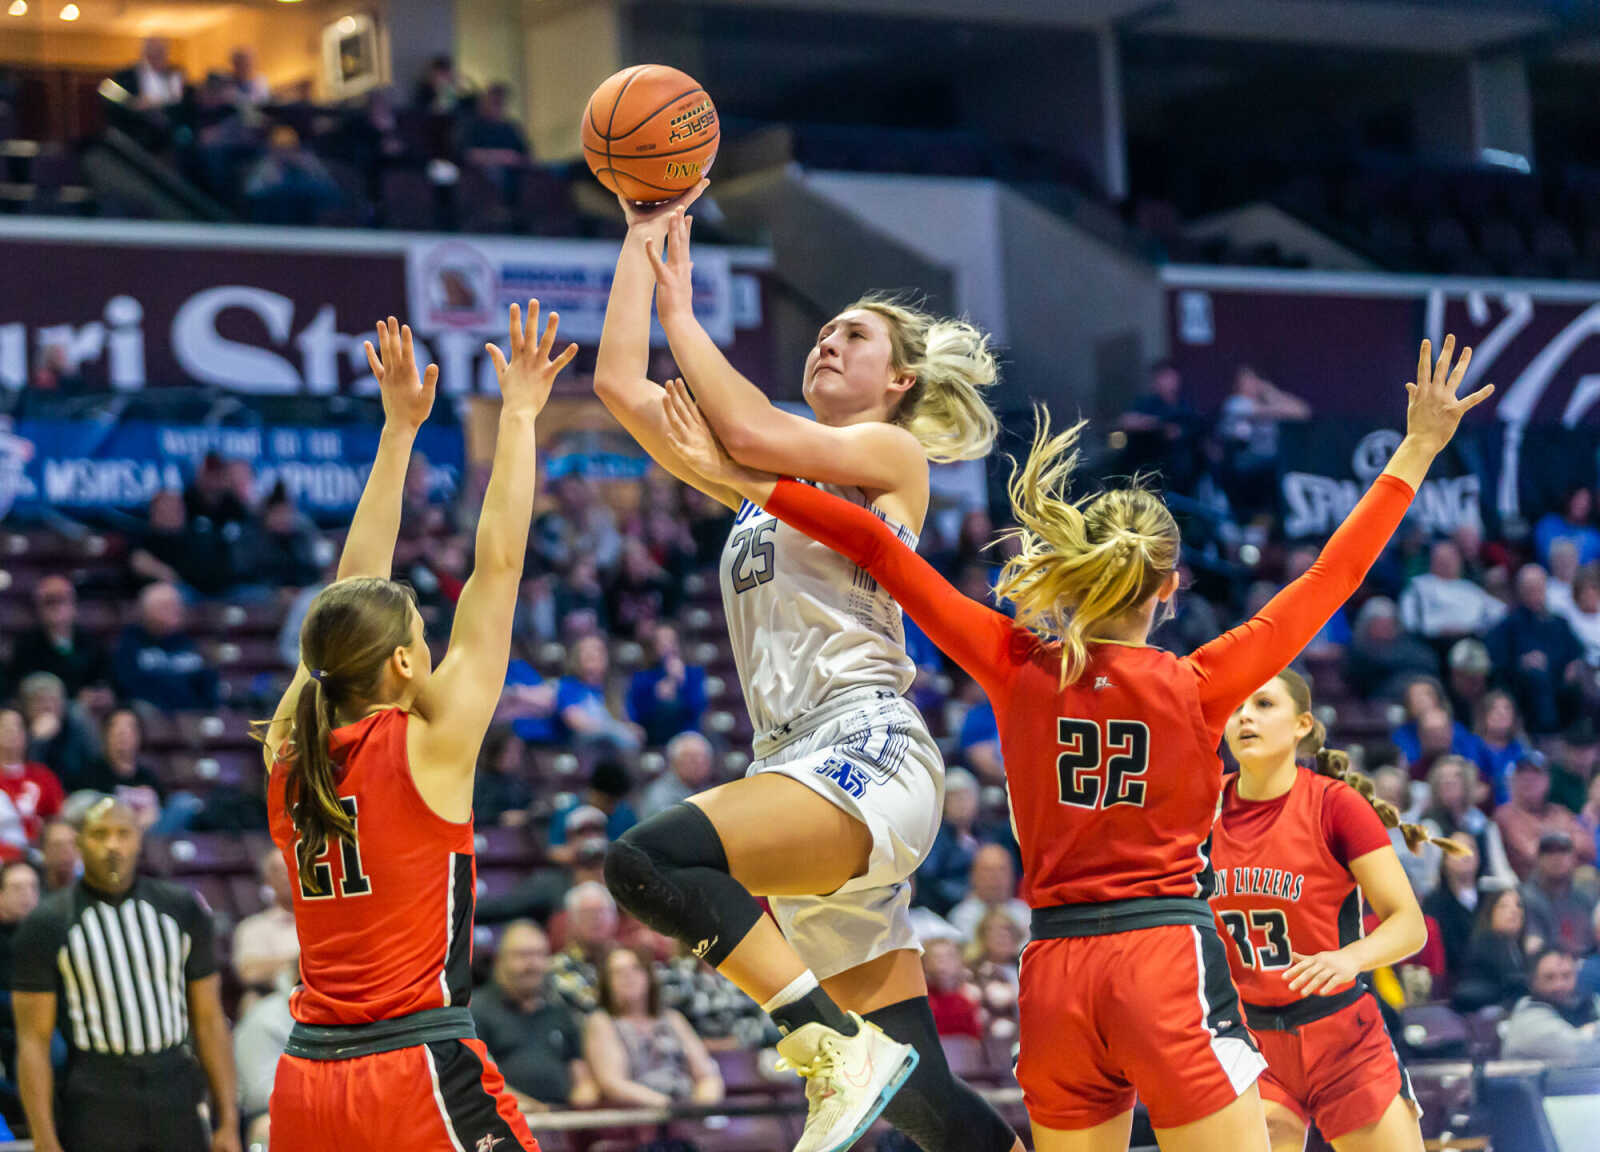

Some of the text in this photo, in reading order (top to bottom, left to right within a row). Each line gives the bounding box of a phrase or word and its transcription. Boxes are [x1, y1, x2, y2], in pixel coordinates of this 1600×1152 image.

[731, 517, 778, 594] 25
[1057, 717, 1149, 809] 22
[293, 795, 372, 900] 21
[1234, 867, 1304, 902] ZIZZERS
[1216, 909, 1293, 971] 33
